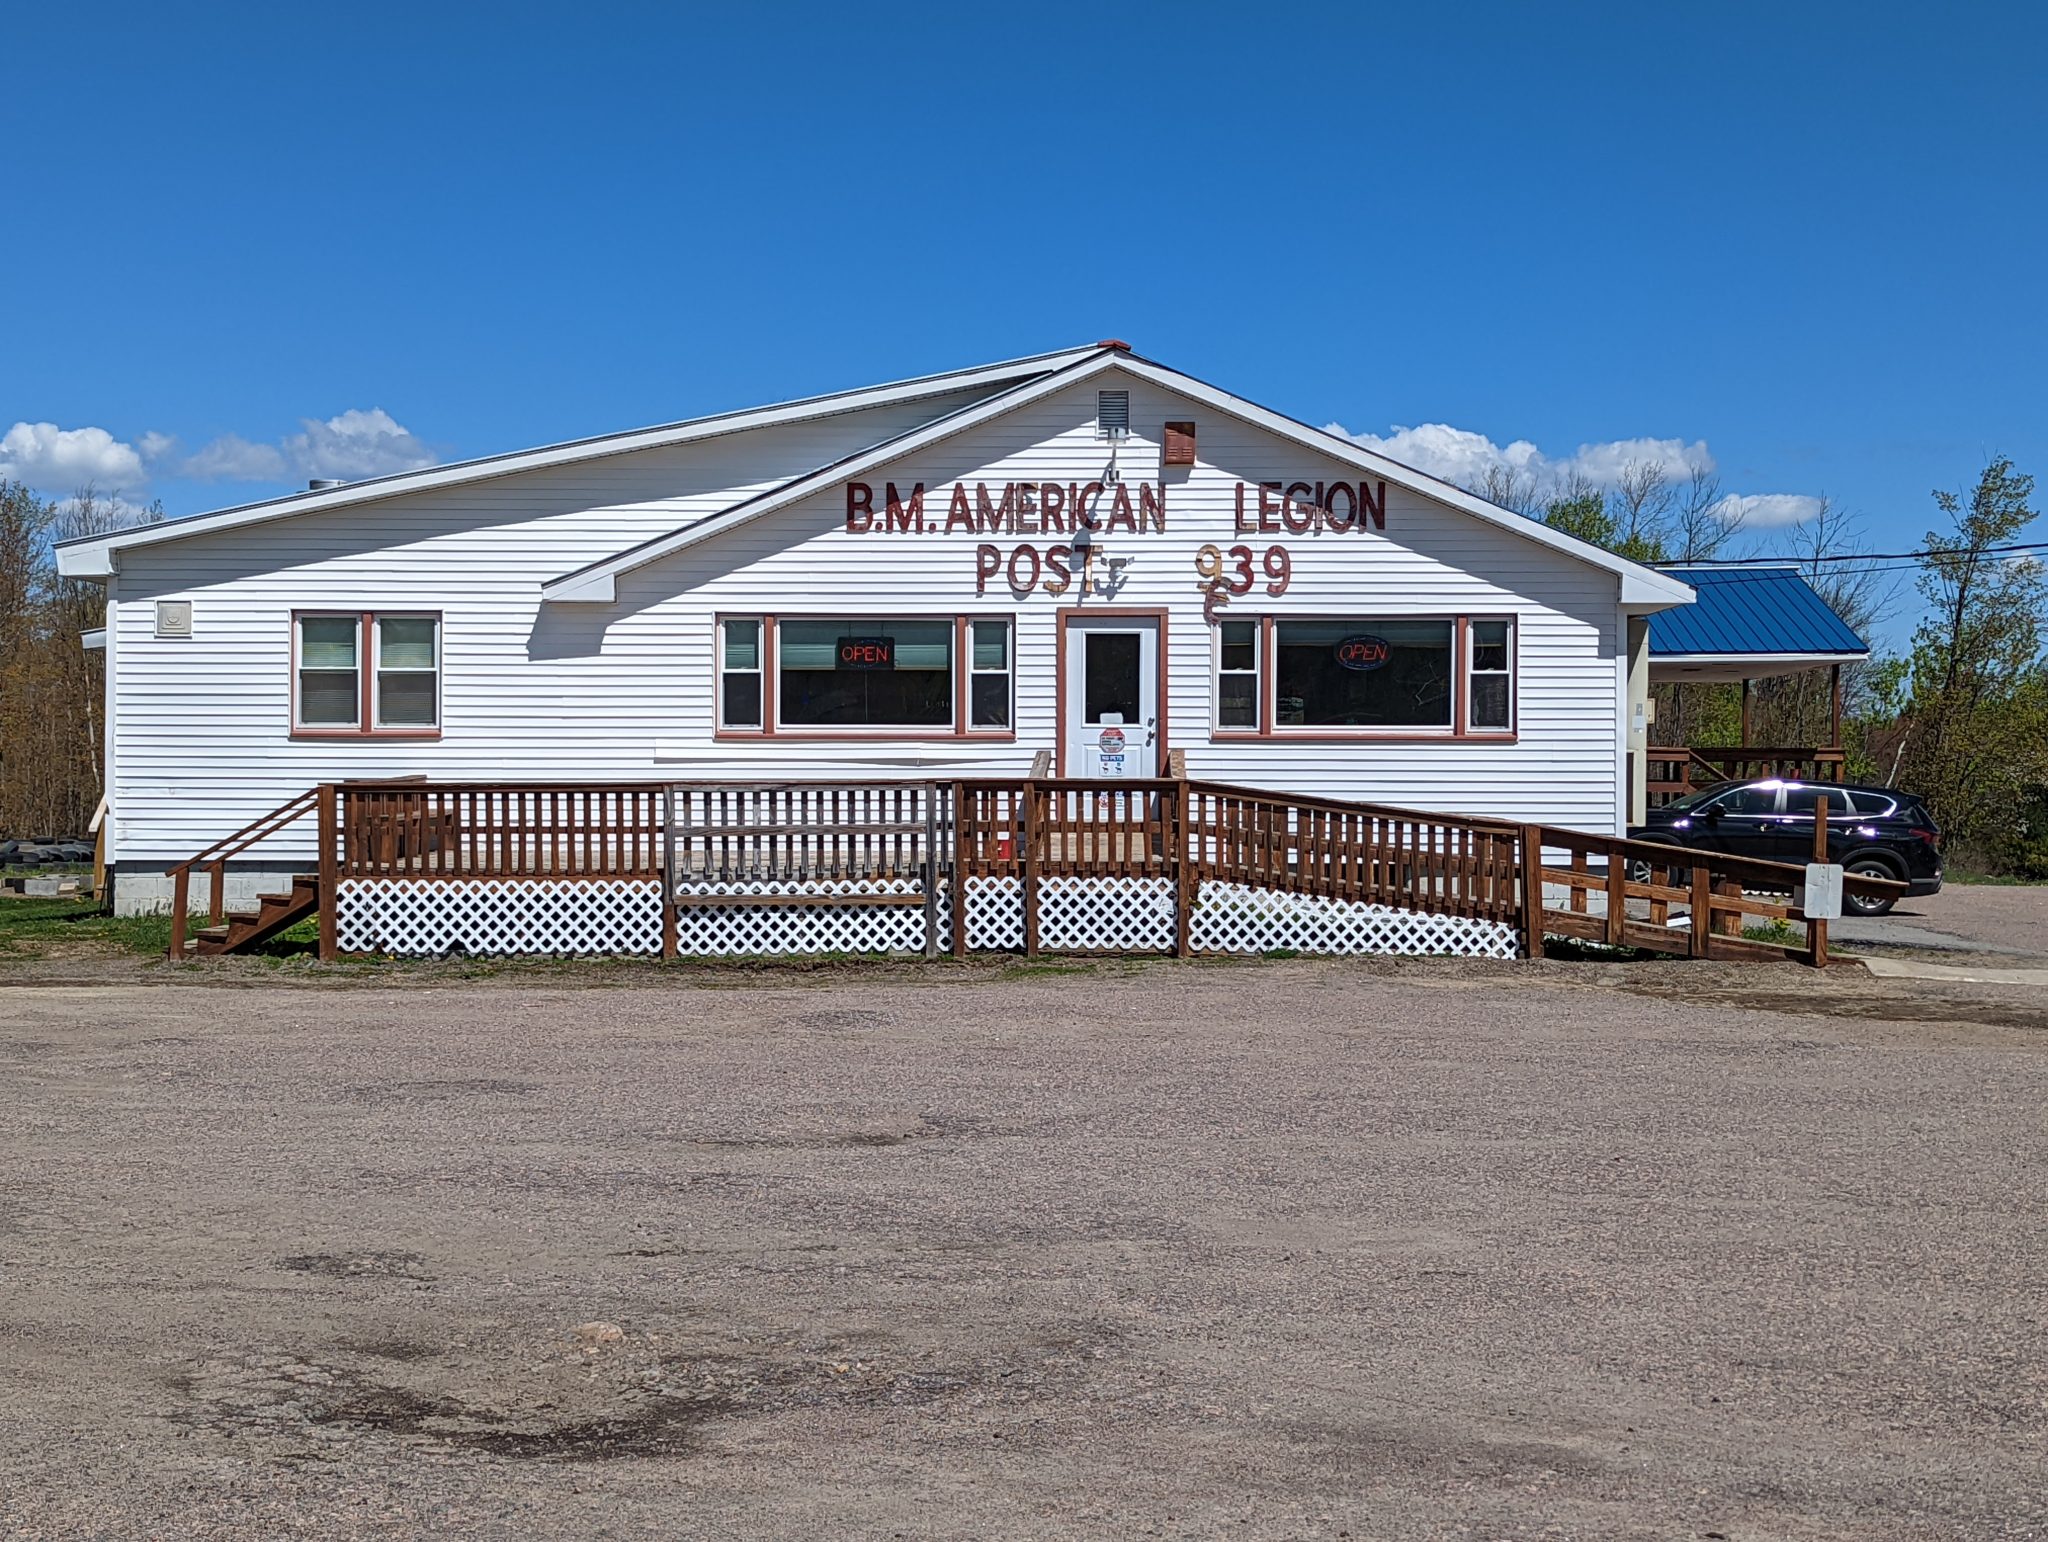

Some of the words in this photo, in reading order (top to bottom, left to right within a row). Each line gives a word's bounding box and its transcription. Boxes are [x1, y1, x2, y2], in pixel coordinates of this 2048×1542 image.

[1235, 481, 1386, 532] LEGION
[976, 544, 1104, 593] POST
[1195, 544, 1291, 593] 939
[842, 645, 888, 663] OPEN
[1339, 643, 1388, 661] OPEN
